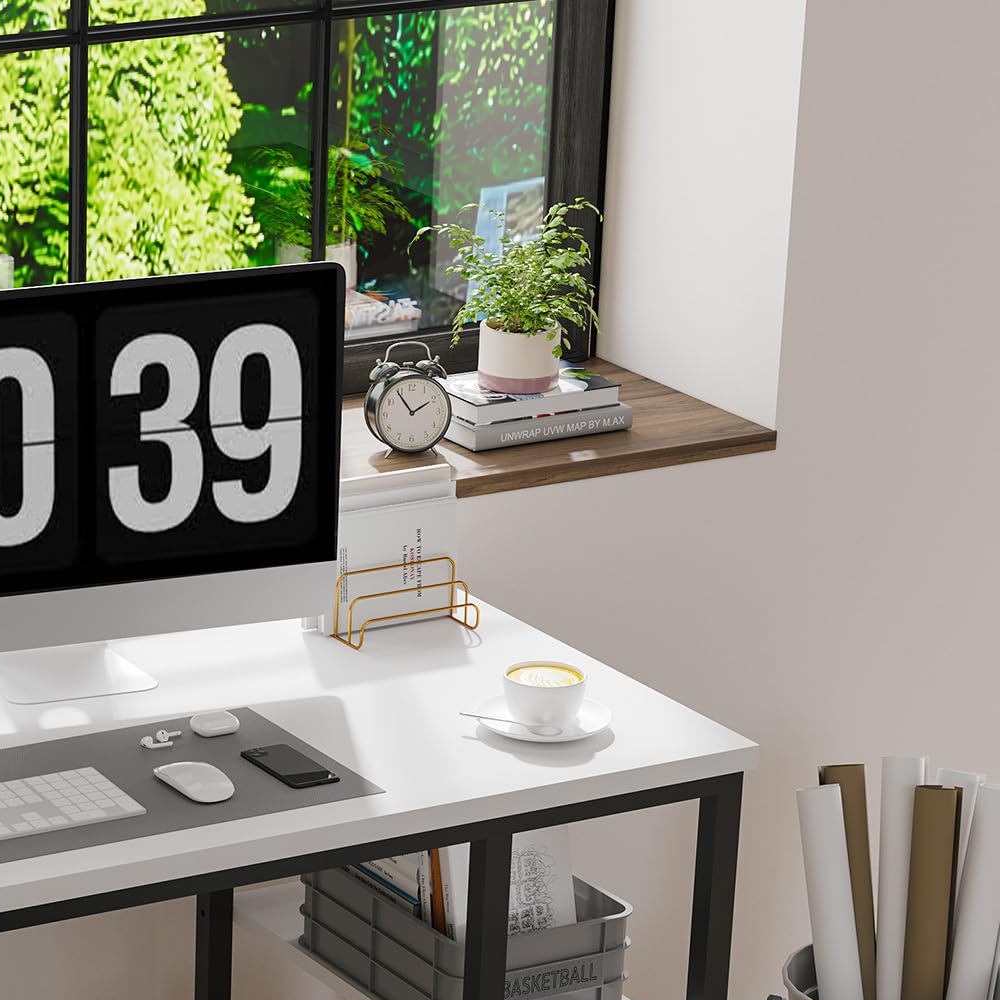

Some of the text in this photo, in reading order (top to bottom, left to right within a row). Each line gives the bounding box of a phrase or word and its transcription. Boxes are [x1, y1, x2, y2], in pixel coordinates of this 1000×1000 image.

[408, 383, 416, 392] 12
[107, 323, 302, 534] 39
[500, 427, 542, 442] UNWRAP
[543, 424, 565, 436] UVW
[566, 421, 587, 433] MAP
[588, 419, 601, 430] BY
[409, 434, 415, 442] 6
[416, 545, 422, 554] TO
[504, 963, 598, 999] BASKETBALL
